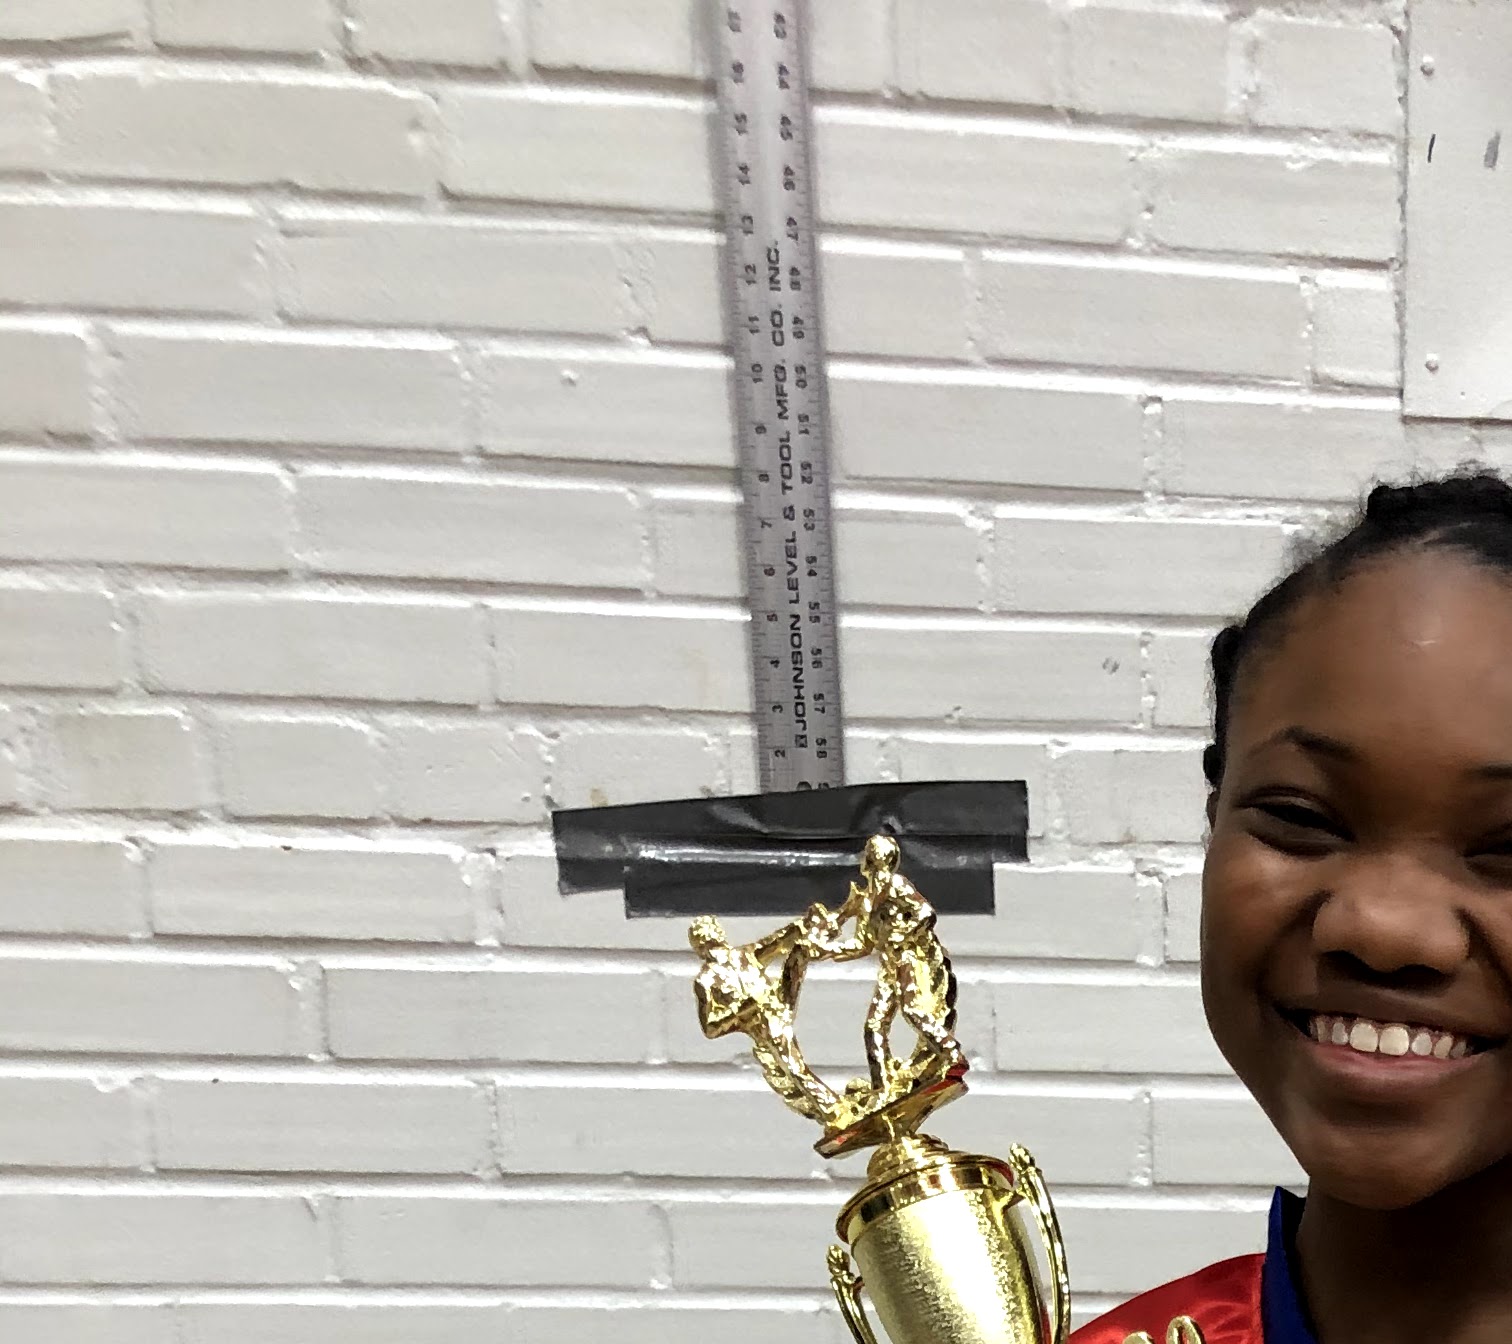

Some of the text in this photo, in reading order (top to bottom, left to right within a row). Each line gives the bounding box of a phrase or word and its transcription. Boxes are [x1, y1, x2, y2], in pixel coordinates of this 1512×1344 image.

[734, 112, 748, 136] 15
[738, 162, 751, 185] 14
[741, 215, 754, 235] 13
[786, 216, 799, 242] 47
[744, 263, 757, 285] 12
[748, 315, 760, 335] 11
[751, 363, 763, 384] 10
[798, 413, 810, 435] 51
[800, 461, 813, 485] 52
[767, 240, 807, 731] JOHNSON LEVEL & TOOL MFG. CO. INC.
[803, 507, 815, 531] 53
[805, 555, 818, 577] 54
[808, 601, 821, 624] 55
[810, 647, 823, 669] 56
[813, 693, 826, 714] 57
[815, 737, 827, 759] 58
